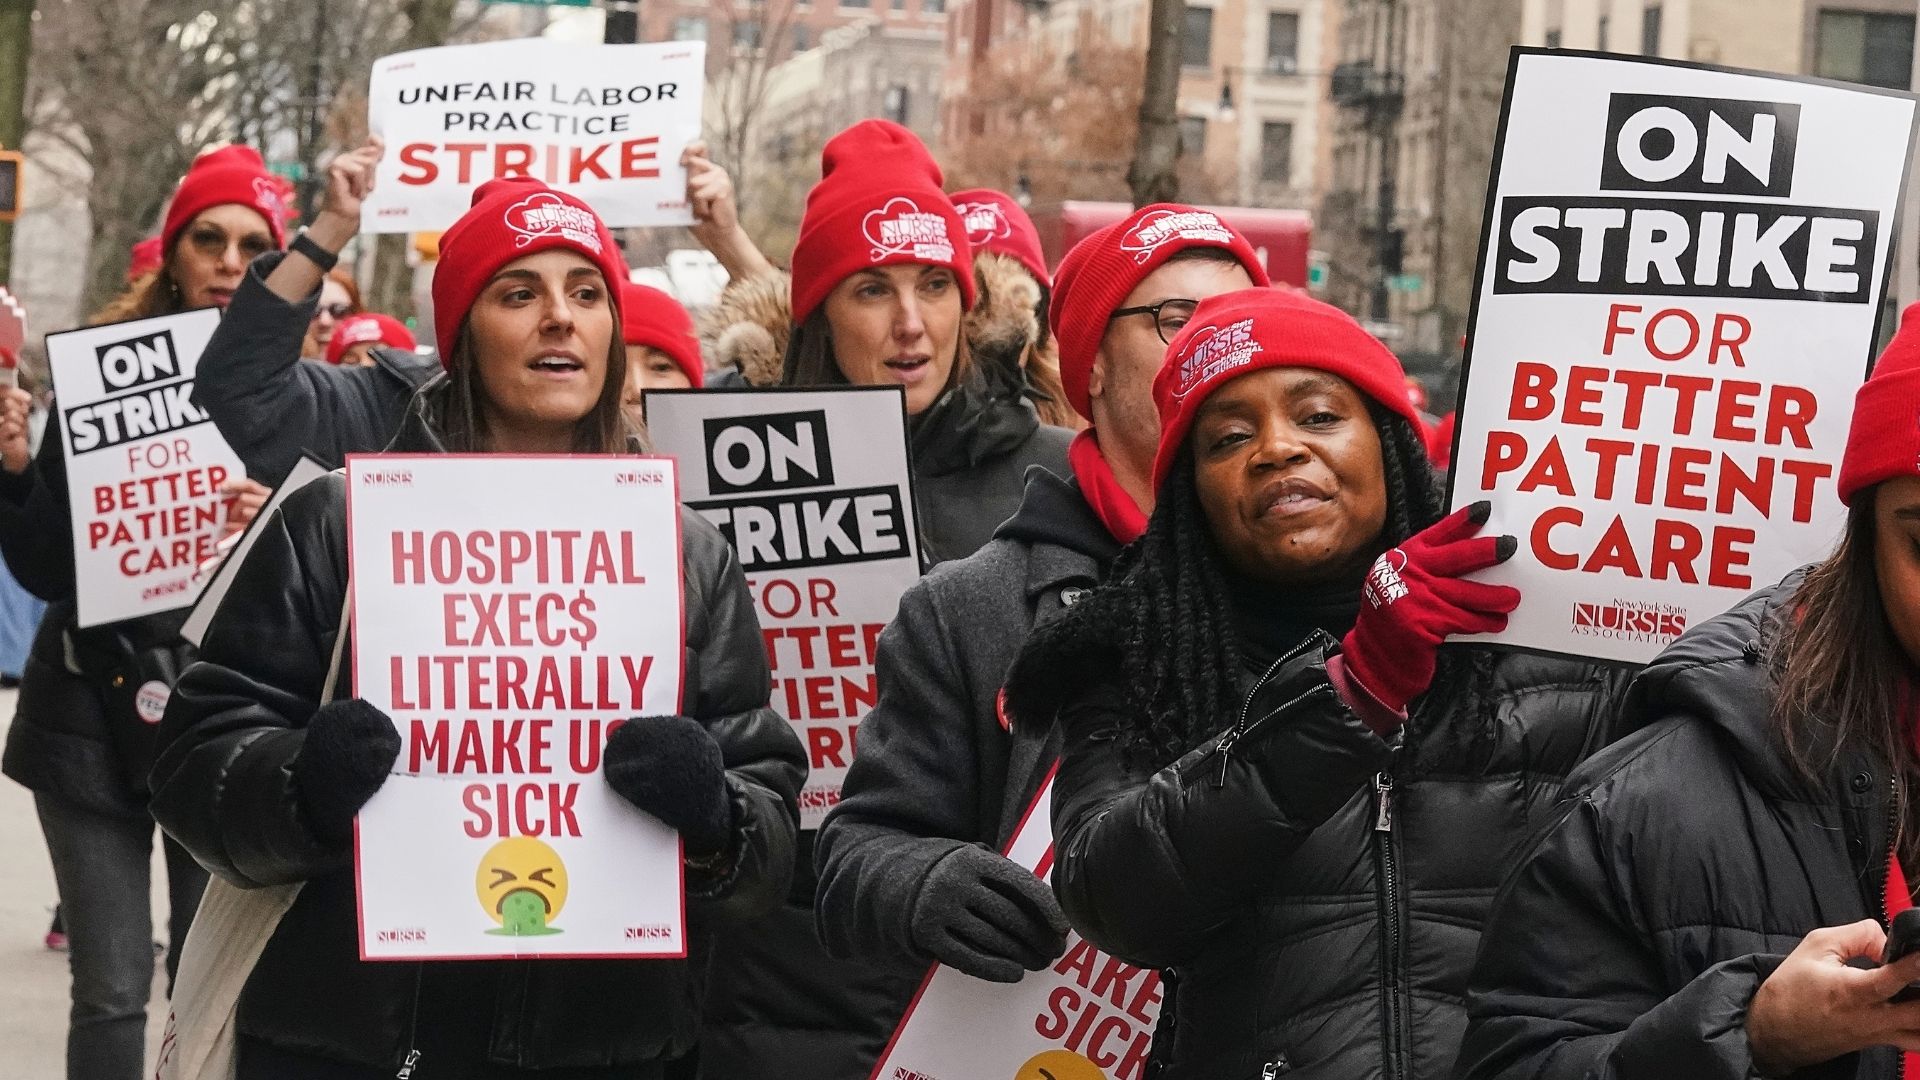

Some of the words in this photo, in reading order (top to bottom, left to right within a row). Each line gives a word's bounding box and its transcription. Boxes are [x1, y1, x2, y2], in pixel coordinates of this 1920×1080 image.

[399, 81, 535, 105] UNFAIR
[551, 82, 679, 107] LABOR
[444, 111, 630, 136] PRACTICE
[1616, 106, 1777, 187] ON
[397, 136, 660, 186] STRIKE
[1507, 206, 1865, 293] STRIKE
[102, 336, 174, 388] ON
[1181, 325, 1252, 381] NURSES
[1602, 303, 1752, 367] FOR
[69, 382, 210, 452] STRIK
[1507, 361, 1818, 450] BETTER
[128, 439, 193, 473] FOR
[713, 421, 819, 486] ON
[1480, 430, 1832, 523] PATIENT
[119, 533, 219, 577] CARE
[391, 530, 646, 584] HOSPITAL
[1530, 506, 1756, 590] CARE
[443, 589, 598, 652] EXEC$
[1572, 602, 1687, 636] NURSES
[1613, 597, 1637, 609] New
[1638, 600, 1661, 613] York
[1663, 603, 1687, 615] State
[1571, 626, 1674, 645] ASSOCIATIO
[390, 656, 654, 710] LITERALLY
[408, 719, 553, 774] MAKE
[462, 783, 582, 838] SICK
[1053, 939, 1162, 1025] AKE
